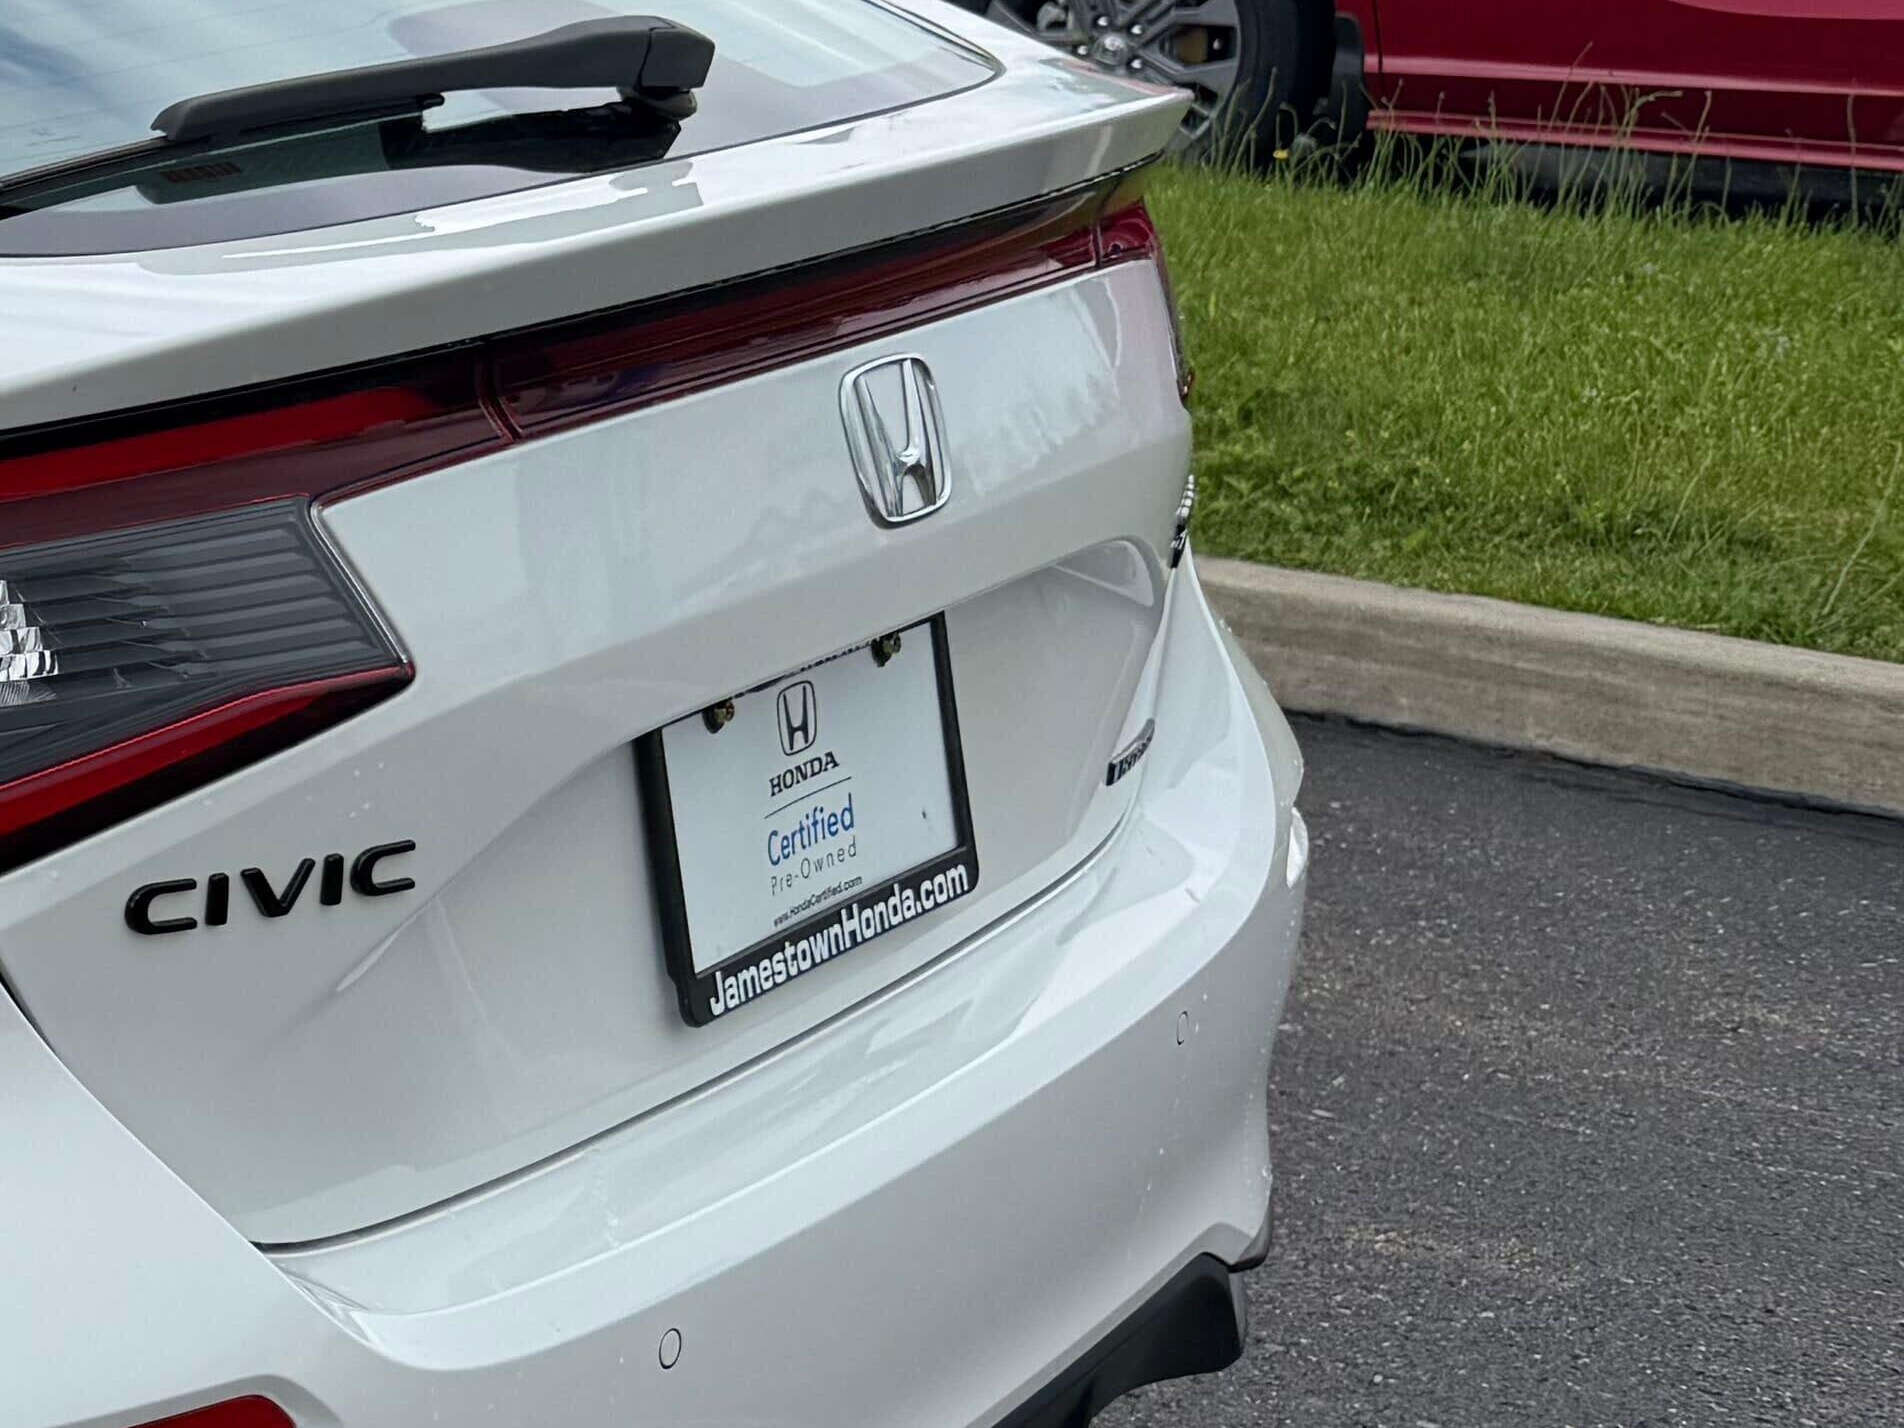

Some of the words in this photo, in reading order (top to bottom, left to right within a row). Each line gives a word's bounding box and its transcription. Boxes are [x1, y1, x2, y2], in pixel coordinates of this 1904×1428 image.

[768, 751, 840, 797] HONDA
[767, 792, 855, 866] Certified
[771, 835, 857, 896] Pre-Owned
[124, 839, 417, 935] CIVIC
[709, 863, 969, 1016] JamestownHonda.com
